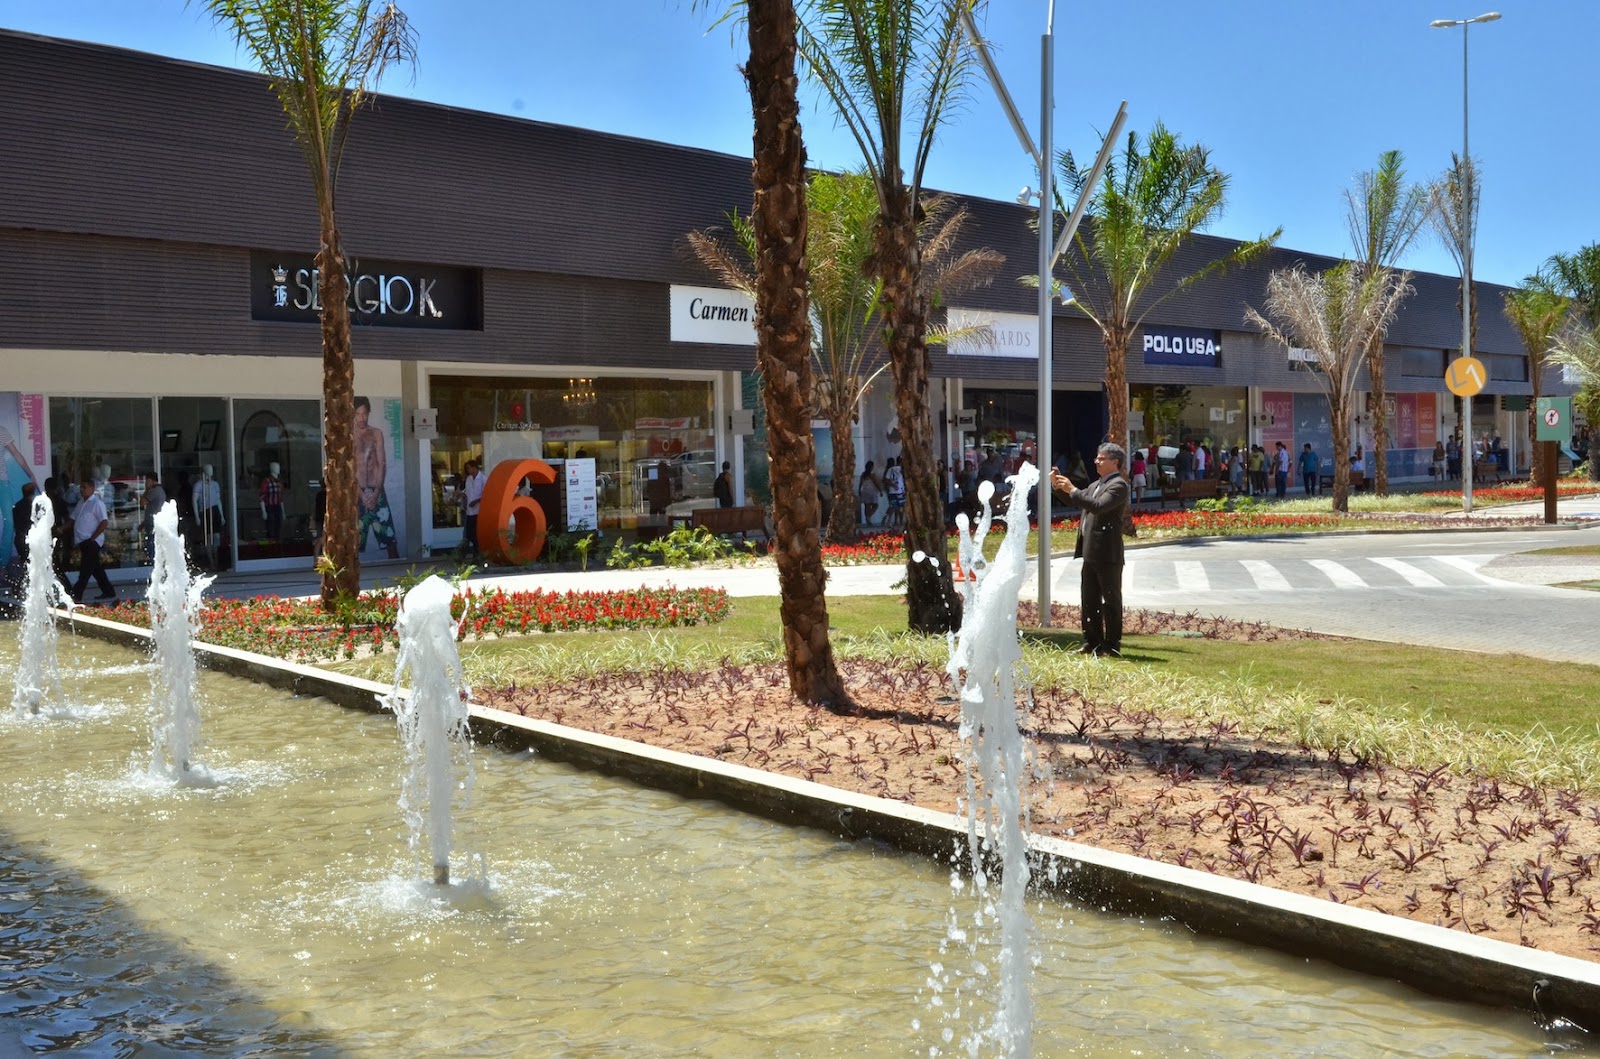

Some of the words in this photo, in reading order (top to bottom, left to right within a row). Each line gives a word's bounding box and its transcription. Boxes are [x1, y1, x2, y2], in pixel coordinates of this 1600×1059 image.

[689, 297, 748, 322] Carmen
[1143, 334, 1183, 354] POLO
[1186, 337, 1216, 356] USA
[476, 458, 557, 566] 6
